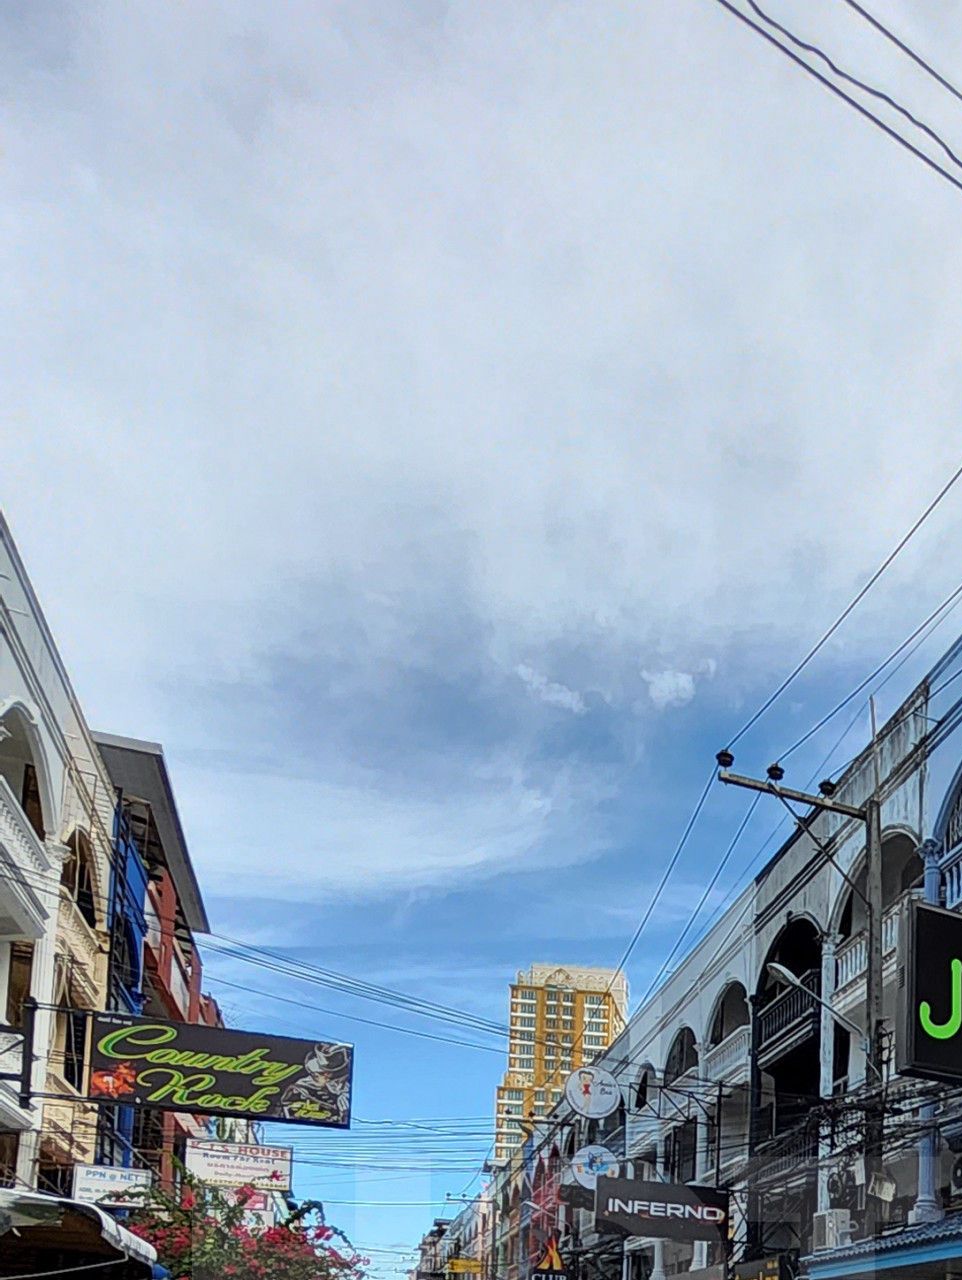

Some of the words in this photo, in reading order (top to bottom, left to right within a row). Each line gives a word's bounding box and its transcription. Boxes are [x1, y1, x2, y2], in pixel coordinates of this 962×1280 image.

[97, 1024, 303, 1085] Country
[137, 1068, 280, 1112] Rock
[239, 1146, 288, 1158] HOUSE
[608, 1197, 722, 1220] INFERNO
